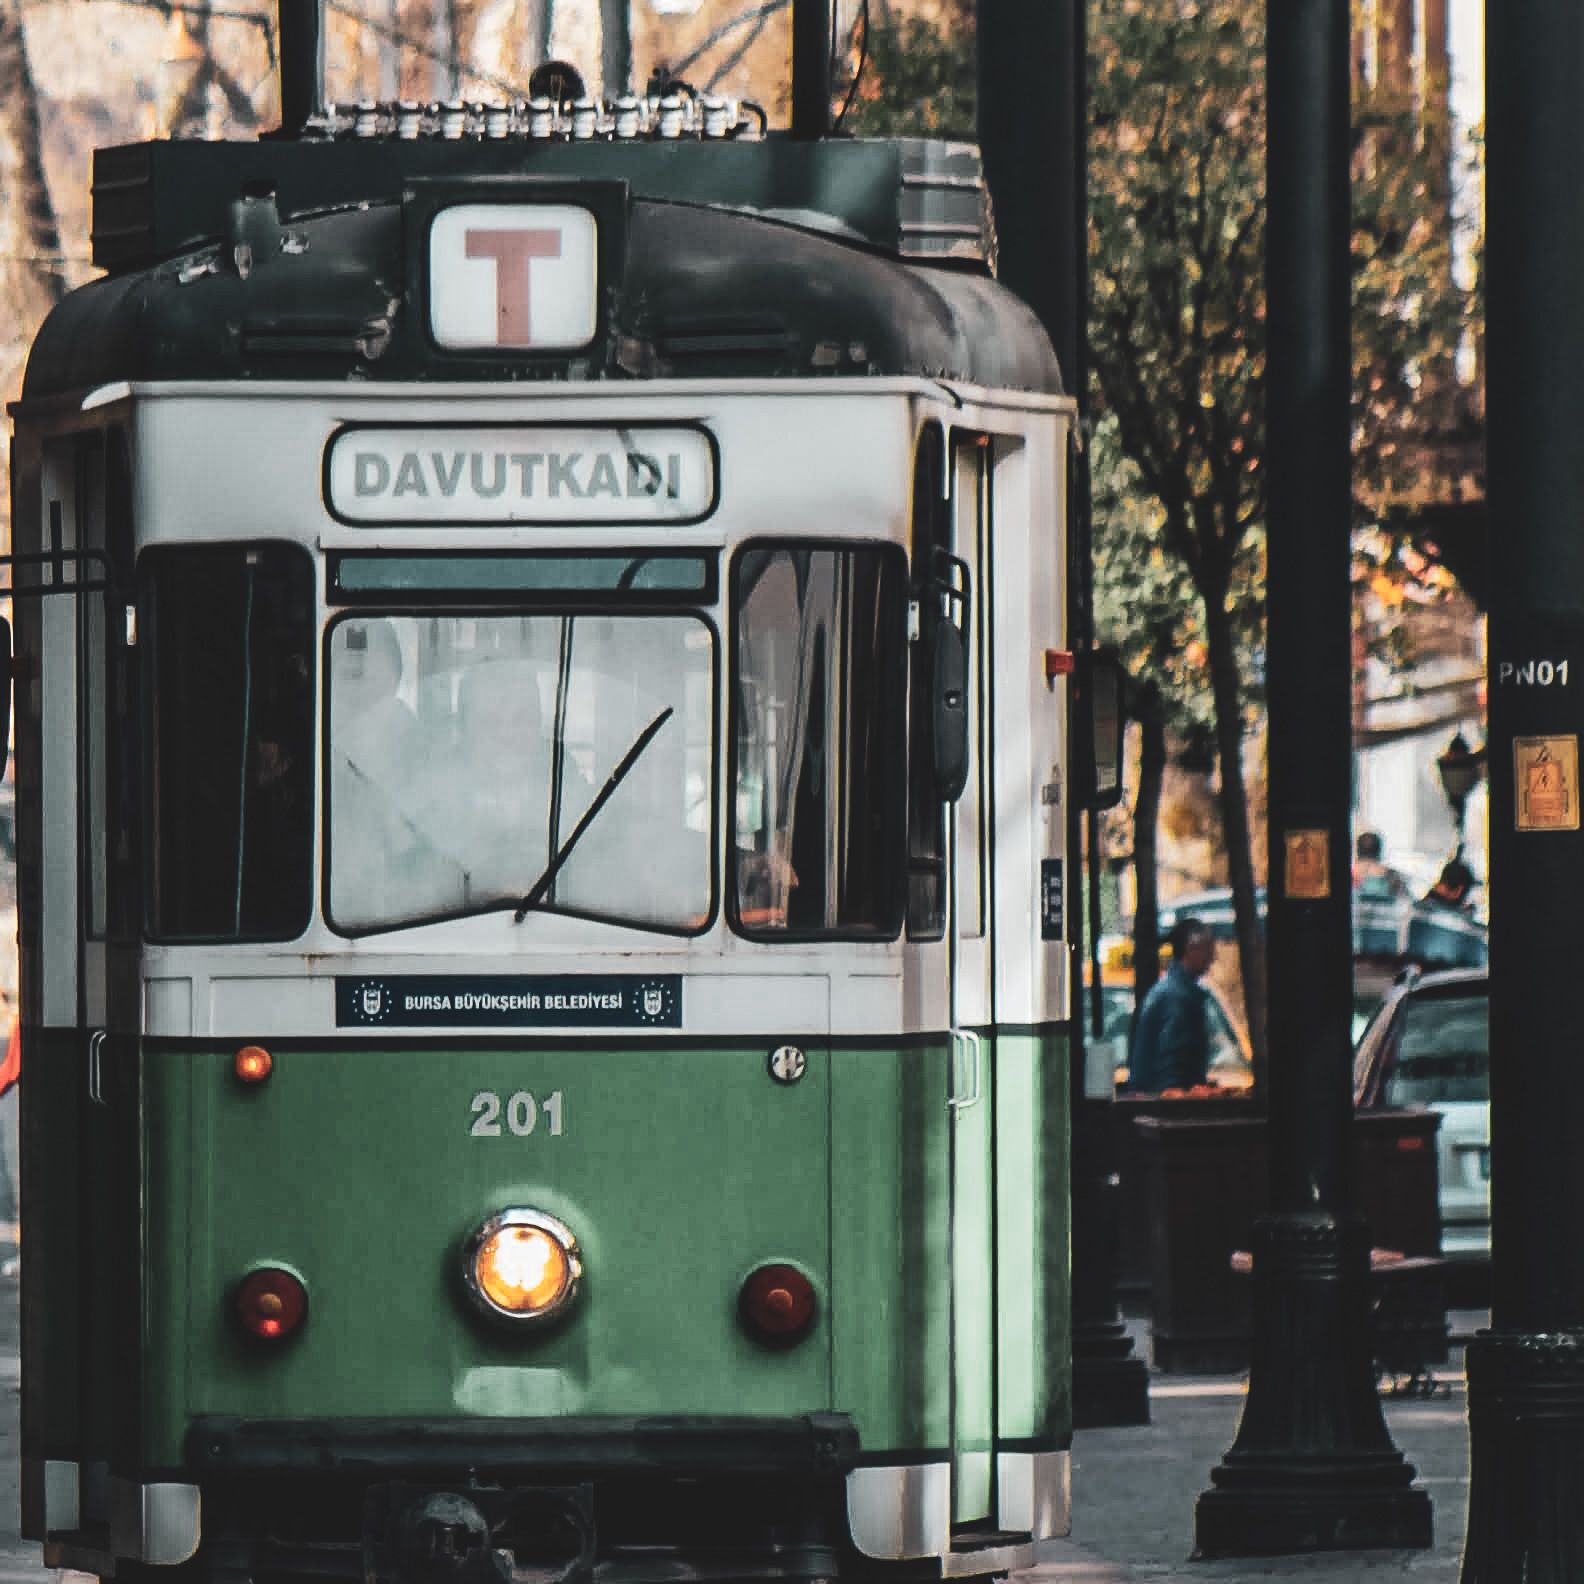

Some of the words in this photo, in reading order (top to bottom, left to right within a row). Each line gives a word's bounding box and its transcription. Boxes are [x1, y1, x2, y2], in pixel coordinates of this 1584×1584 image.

[465, 229, 562, 346] T
[354, 452, 681, 499] DAVUTKADI
[1499, 660, 1568, 686] PN01
[405, 994, 451, 1010] BURSA
[454, 992, 541, 1013] BÜYÜKŞEHİR
[544, 991, 623, 1010] BELEDİYESİ
[471, 1091, 563, 1137] 201
